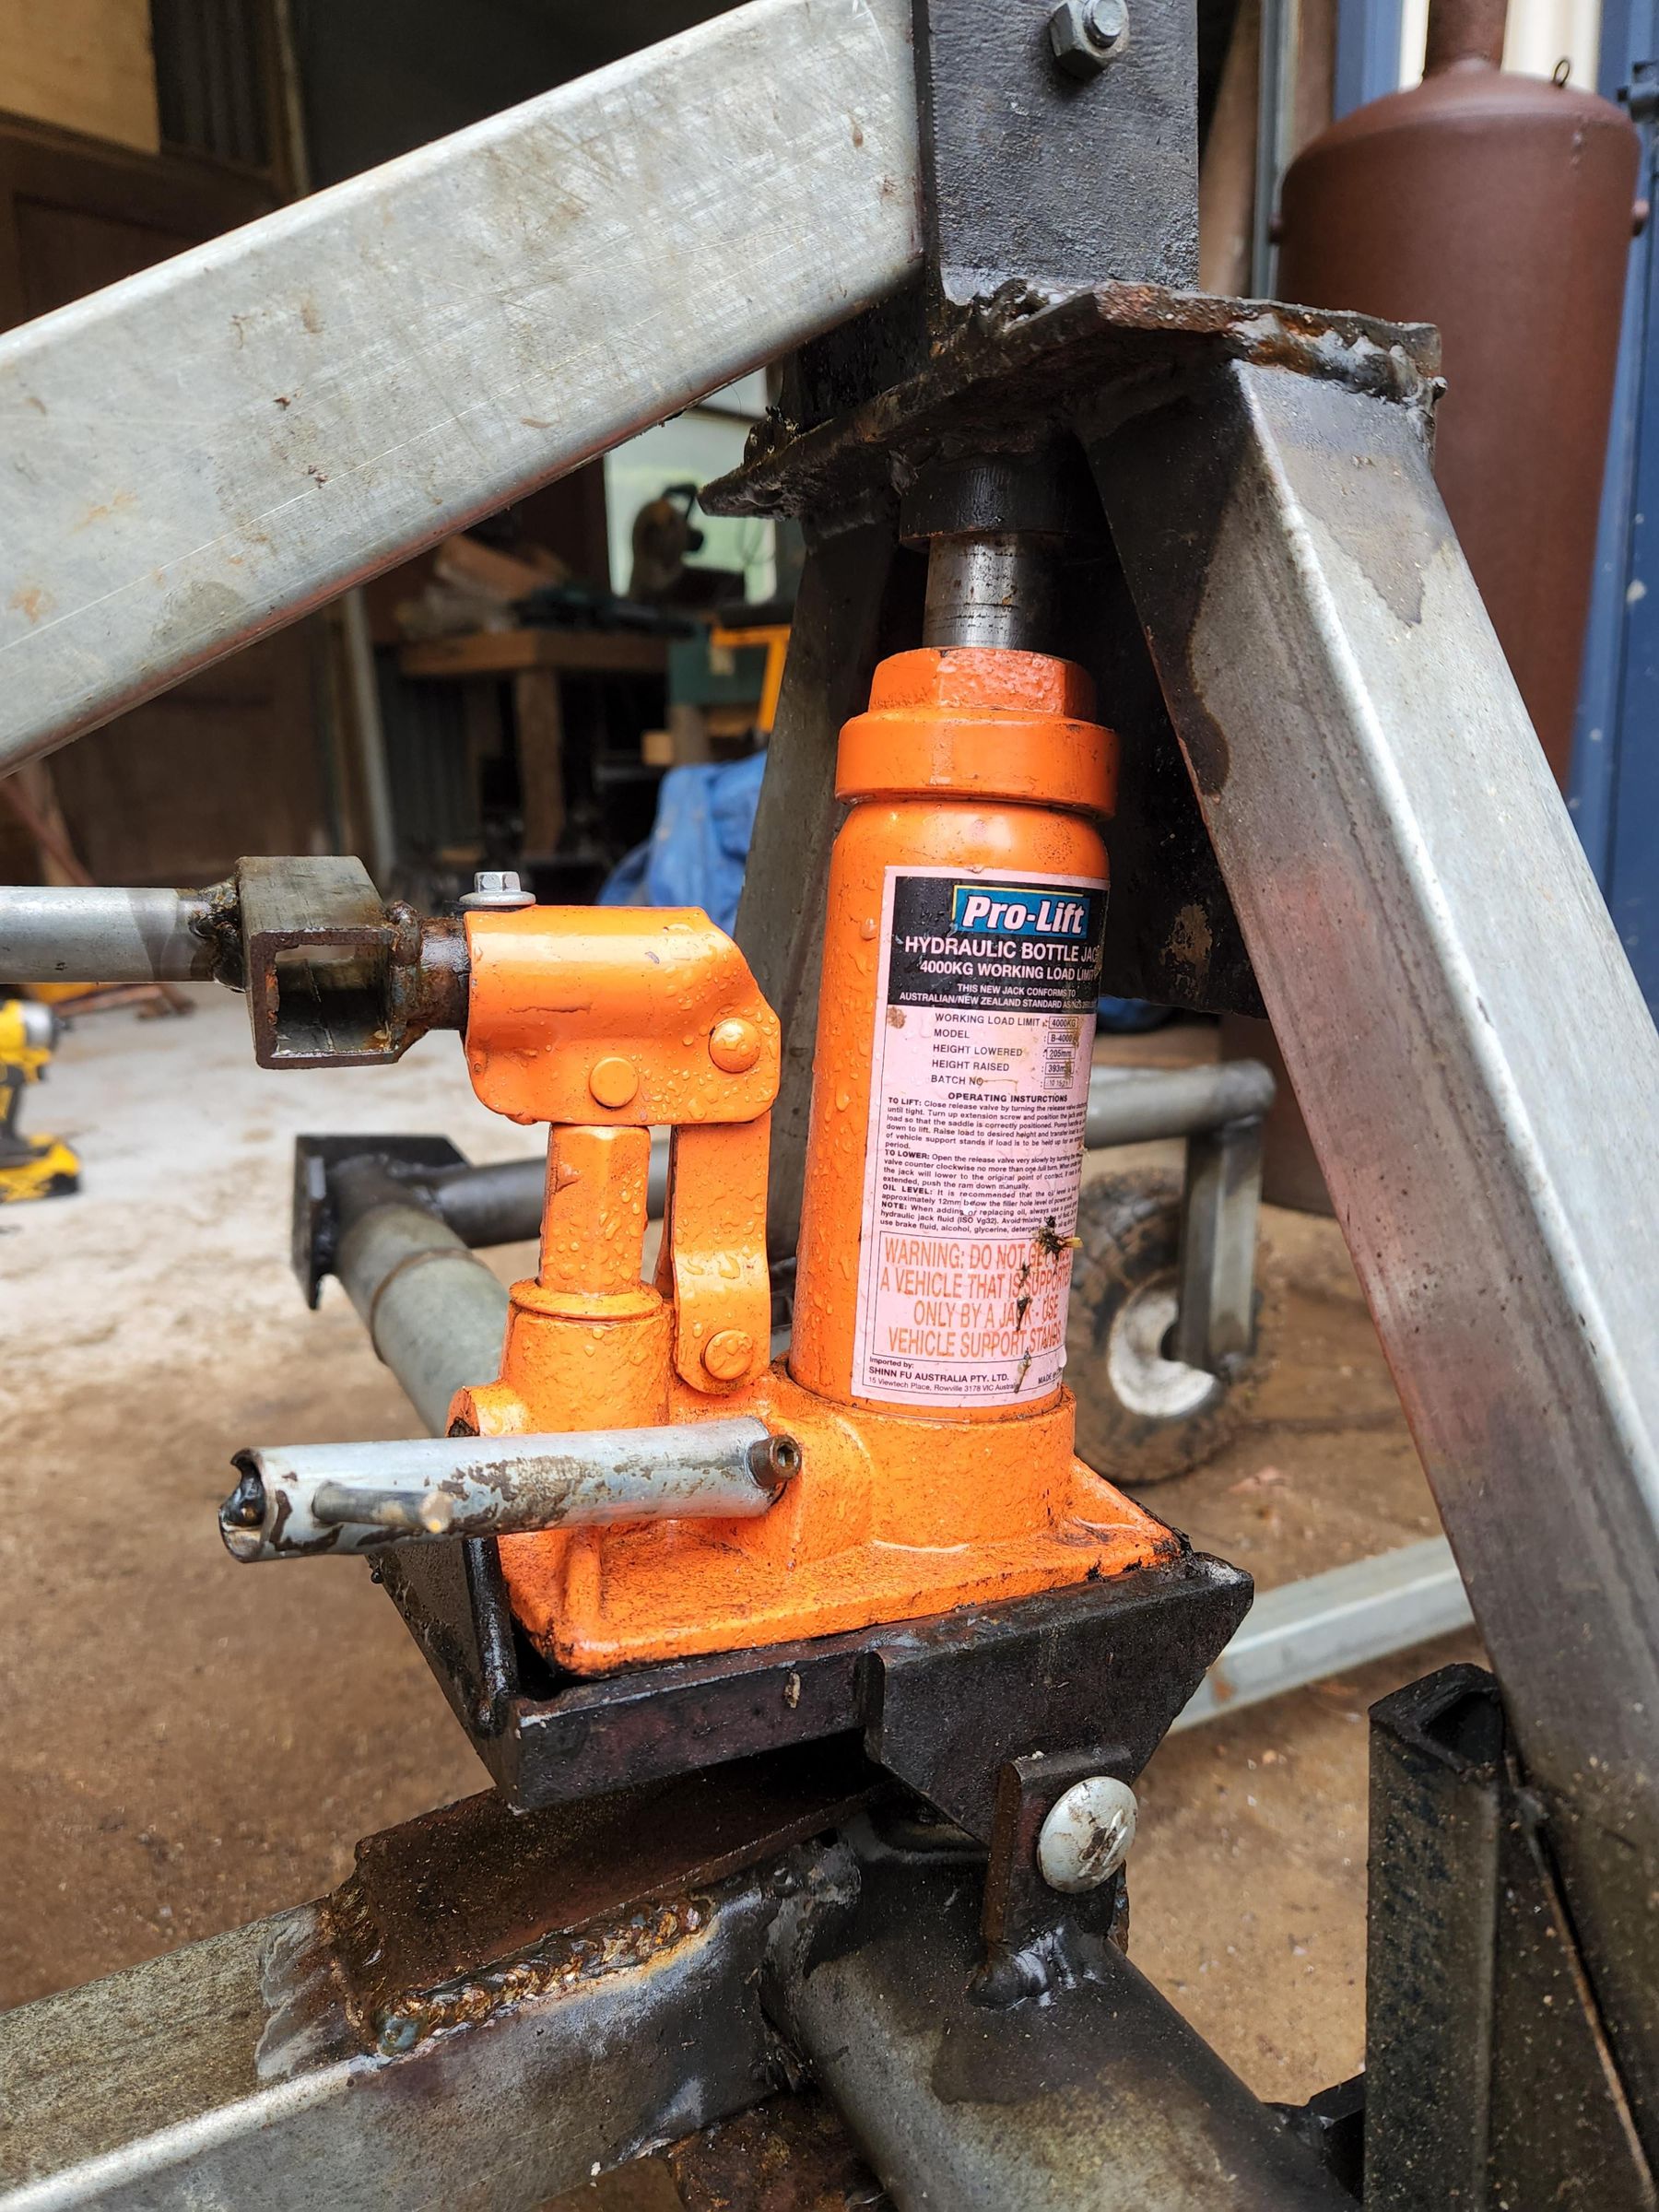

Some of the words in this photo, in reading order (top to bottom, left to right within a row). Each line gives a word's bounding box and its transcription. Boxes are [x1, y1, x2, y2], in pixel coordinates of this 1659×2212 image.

[961, 894, 1086, 935] Pro-Lift
[905, 935, 1017, 959] HYDRAULIC
[1021, 942, 1079, 961] BOTTLE
[1080, 946, 1100, 963] JAC
[920, 960, 973, 975] 4000KG
[978, 963, 1044, 979] WORKING
[1046, 966, 1075, 981] LOAD
[957, 983, 978, 993] THIS
[980, 984, 1001, 994] NEW
[1002, 986, 1025, 995] JACK
[1027, 987, 1067, 997] CONFORMS
[1068, 989, 1077, 998] TO
[899, 992, 979, 1005] AUSTRALIAN/NEW
[980, 996, 1021, 1006] ZEALAND
[1022, 998, 1063, 1009] STANDARD
[935, 1013, 984, 1024] WORKING
[988, 1016, 1015, 1026] LOAD
[1018, 1018, 1041, 1027] LIMIT
[1052, 1018, 1077, 1028] 4000KG
[934, 1029, 971, 1039] MODEL
[933, 1043, 971, 1054] HEIGHT
[974, 1047, 1023, 1057] LOWERED
[1049, 1049, 1073, 1058] 205mm
[932, 1059, 971, 1070] HEIGHT
[972, 1062, 1010, 1072] RAISED
[1048, 1064, 1071, 1073] 393m
[931, 1075, 966, 1085] BATCH
[947, 1092, 1007, 1102] OPERATING
[1010, 1095, 1068, 1103] INSTURCTIONS
[905, 1108, 924, 1116] tight.
[928, 1109, 946, 1117] Turn
[1000, 1104, 1009, 1112] by
[895, 1134, 923, 1142] vehicle
[885, 1141, 911, 1149] period.
[898, 1150, 930, 1159] LOWER:
[936, 1163, 975, 1171] clockwise
[883, 1176, 920, 1186] extended,
[901, 1185, 933, 1195] LEVEL:
[881, 1193, 936, 1206] approximately
[881, 1201, 907, 1210] NOTE:
[911, 1205, 933, 1213] When
[880, 1209, 915, 1219] hydraulic
[917, 1214, 934, 1222] jack
[919, 1223, 938, 1231] fluid,
[941, 1225, 972, 1233] alcohol,
[974, 1226, 1009, 1234] glycerine,
[885, 1236, 965, 1268] WARNING:
[970, 1243, 993, 1268] DO
[996, 1243, 1026, 1269] NOT
[879, 1267, 889, 1292] A
[895, 1267, 962, 1298] VEHICLE
[969, 1274, 1006, 1299] THAT
[1008, 1272, 1021, 1299] IS
[913, 1300, 956, 1327] ONLY
[960, 1302, 982, 1328] BY
[986, 1303, 994, 1328] A
[1041, 1294, 1059, 1324] USE
[888, 1326, 955, 1357] VEHICLE
[960, 1330, 1027, 1358] SUPPORT
[869, 1356, 901, 1368] Imported
[903, 1360, 914, 1369] by:
[869, 1366, 898, 1378] SHINN
[900, 1371, 912, 1379] FU
[914, 1372, 968, 1382] AUSTRALIA
[970, 1374, 990, 1382] PTY.
[992, 1373, 1009, 1382] LTD.
[878, 1378, 909, 1388] Viewtech
[911, 1383, 932, 1392] Place,
